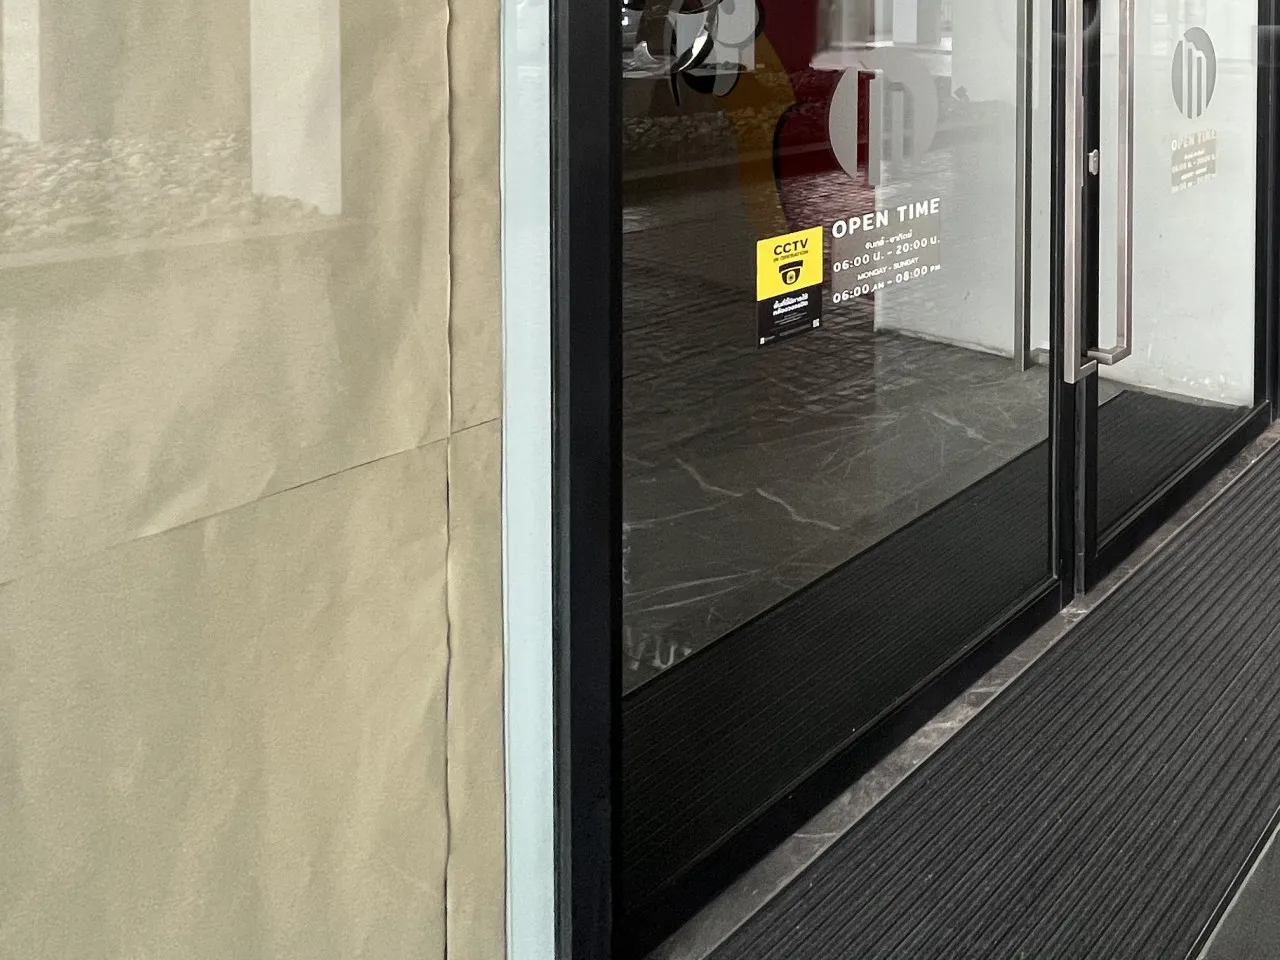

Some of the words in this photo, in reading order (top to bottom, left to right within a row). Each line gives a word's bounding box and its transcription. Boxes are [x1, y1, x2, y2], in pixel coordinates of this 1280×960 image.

[832, 209, 889, 239] OPEN
[897, 198, 941, 222] TIME
[774, 238, 809, 256] CCTV
[833, 254, 869, 273] 06:00
[896, 240, 928, 255] 20:00
[832, 285, 869, 304] 06:00
[896, 266, 928, 283] 08:00
[857, 266, 887, 280] MONDAY
[893, 257, 919, 271] SUNDAY
